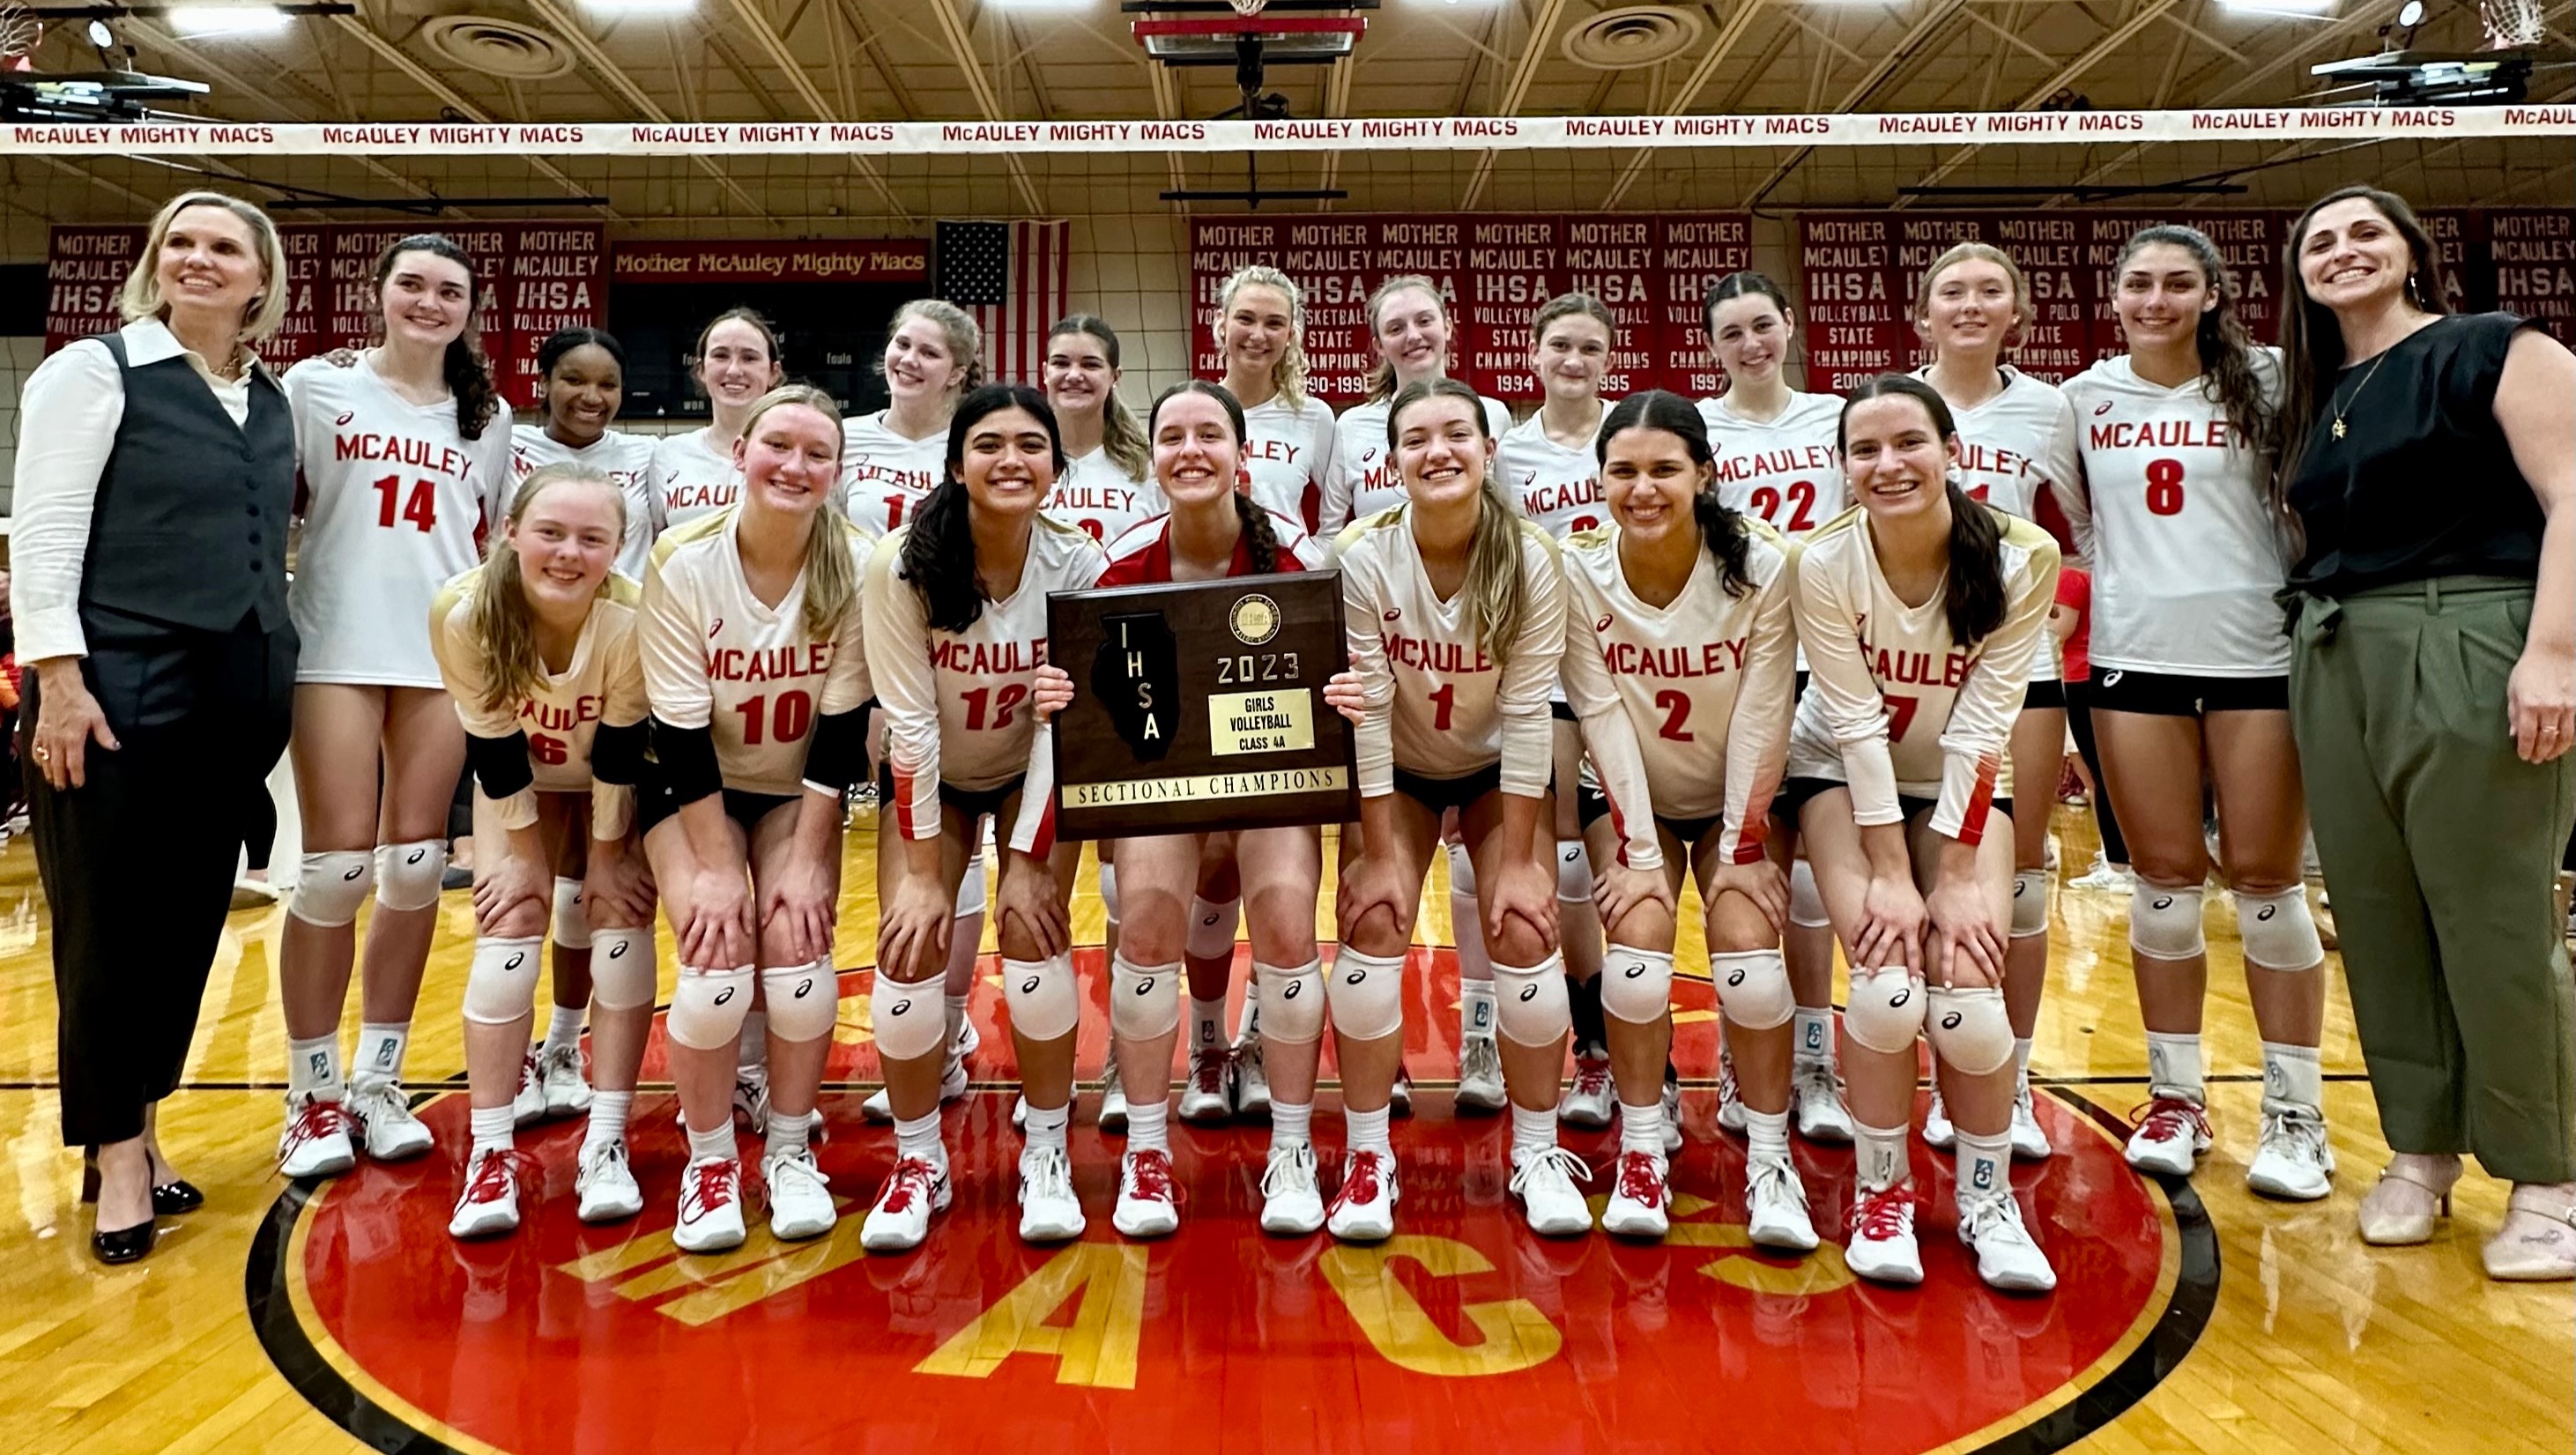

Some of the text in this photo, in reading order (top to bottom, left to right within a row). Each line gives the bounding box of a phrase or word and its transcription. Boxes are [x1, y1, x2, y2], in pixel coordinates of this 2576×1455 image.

[1880, 115, 2142, 132] McAULEY MIGHTY MACS
[2194, 111, 2455, 129] McAULEY MIGHTY MACS
[2505, 109, 2576, 124] McAUL
[15, 128, 273, 143] McAULEY MIGHTY MACS
[323, 128, 583, 143] McAULEY MIGHTY MACS
[633, 126, 893, 142] McAULEY MIGHTY MACS
[944, 124, 1204, 141] McAULEY MIGHTY MACS
[1255, 122, 1517, 139] McAULEY MIGHTY MACS
[1567, 119, 1829, 136] McAULEY MIGHTY MACS
[1199, 226, 1273, 246] MOTHER
[1292, 225, 1367, 246] MOTHER
[1383, 224, 1459, 244] MOTHER
[1475, 224, 1551, 244] MOTHER
[1570, 223, 1646, 244] MOTHER
[1668, 223, 1744, 243] MOTHER
[1808, 222, 1886, 242] MOTHER
[1904, 220, 1980, 241] MOTHER
[1999, 219, 2075, 241] MOTHER
[2493, 215, 2571, 237] MOTHER
[58, 234, 131, 255] MOTHER
[284, 234, 318, 255] HER
[337, 234, 406, 254] MOTHE
[447, 233, 502, 253] THER
[520, 231, 594, 251] MOTHER
[2491, 240, 2576, 262] MCAULEY
[513, 256, 598, 277] MCAULEY
[615, 252, 926, 276] Mother McAuley Mighty Macs
[1194, 251, 1279, 271] MCAULEY
[1287, 250, 1371, 271] MCAULEY
[1377, 249, 1462, 270] MCAULEY
[1470, 249, 1556, 270] MCAULEY
[1566, 248, 1652, 270] MCAULEY
[1663, 248, 1749, 269] MCAULEY
[1804, 246, 1889, 268] MCAULEY
[48, 259, 133, 280] MCAULEY
[1476, 274, 1551, 302] IHSA
[1572, 274, 1647, 302] IHSA
[1669, 274, 1719, 301] IHS
[1811, 271, 1886, 301] IHSA
[2498, 267, 2574, 296] IHSA
[49, 285, 123, 314] IHSA
[516, 281, 590, 310] IHSA
[514, 313, 591, 331] VOLLEYBALL
[1474, 307, 1539, 324] VOLLEYBA
[1809, 305, 1892, 323] VOLLEYBALL
[2049, 303, 2080, 321] POLO
[1309, 330, 1352, 348] STATE
[1829, 327, 1874, 345] STATE
[2030, 326, 2062, 344] TATE
[255, 339, 298, 356] STATE
[1305, 353, 1368, 371] AMPIONS
[1475, 352, 1534, 370] CHAMPI
[1814, 350, 1891, 367] CHAMPIONS
[1496, 375, 1534, 392] 1994
[1599, 375, 1629, 391] 995
[335, 434, 472, 481] MCAULEY
[1717, 445, 1836, 483] MCAULEY
[1959, 445, 2032, 478] ULEY
[857, 466, 935, 491] MCAUL
[2146, 458, 2185, 516] 8
[373, 474, 437, 533] 14
[1038, 487, 1136, 512] AULEY
[1750, 480, 1815, 532] 22
[927, 637, 1048, 676] MCAULE
[1380, 633, 1494, 673] MCAULE
[1217, 652, 1300, 685] 2023
[521, 695, 605, 731] AULE
[1244, 696, 1275, 712] GIRLS
[1428, 684, 1454, 731] 1
[735, 690, 812, 746] 10
[1230, 714, 1292, 732] VOLLEYBALL
[1654, 689, 1695, 742] 2
[1882, 694, 1919, 744] 7
[529, 731, 568, 765] 6
[1239, 737, 1286, 751] CLASS 4A
[1079, 769, 1333, 804] SECTIONAL CHAMPIONS
